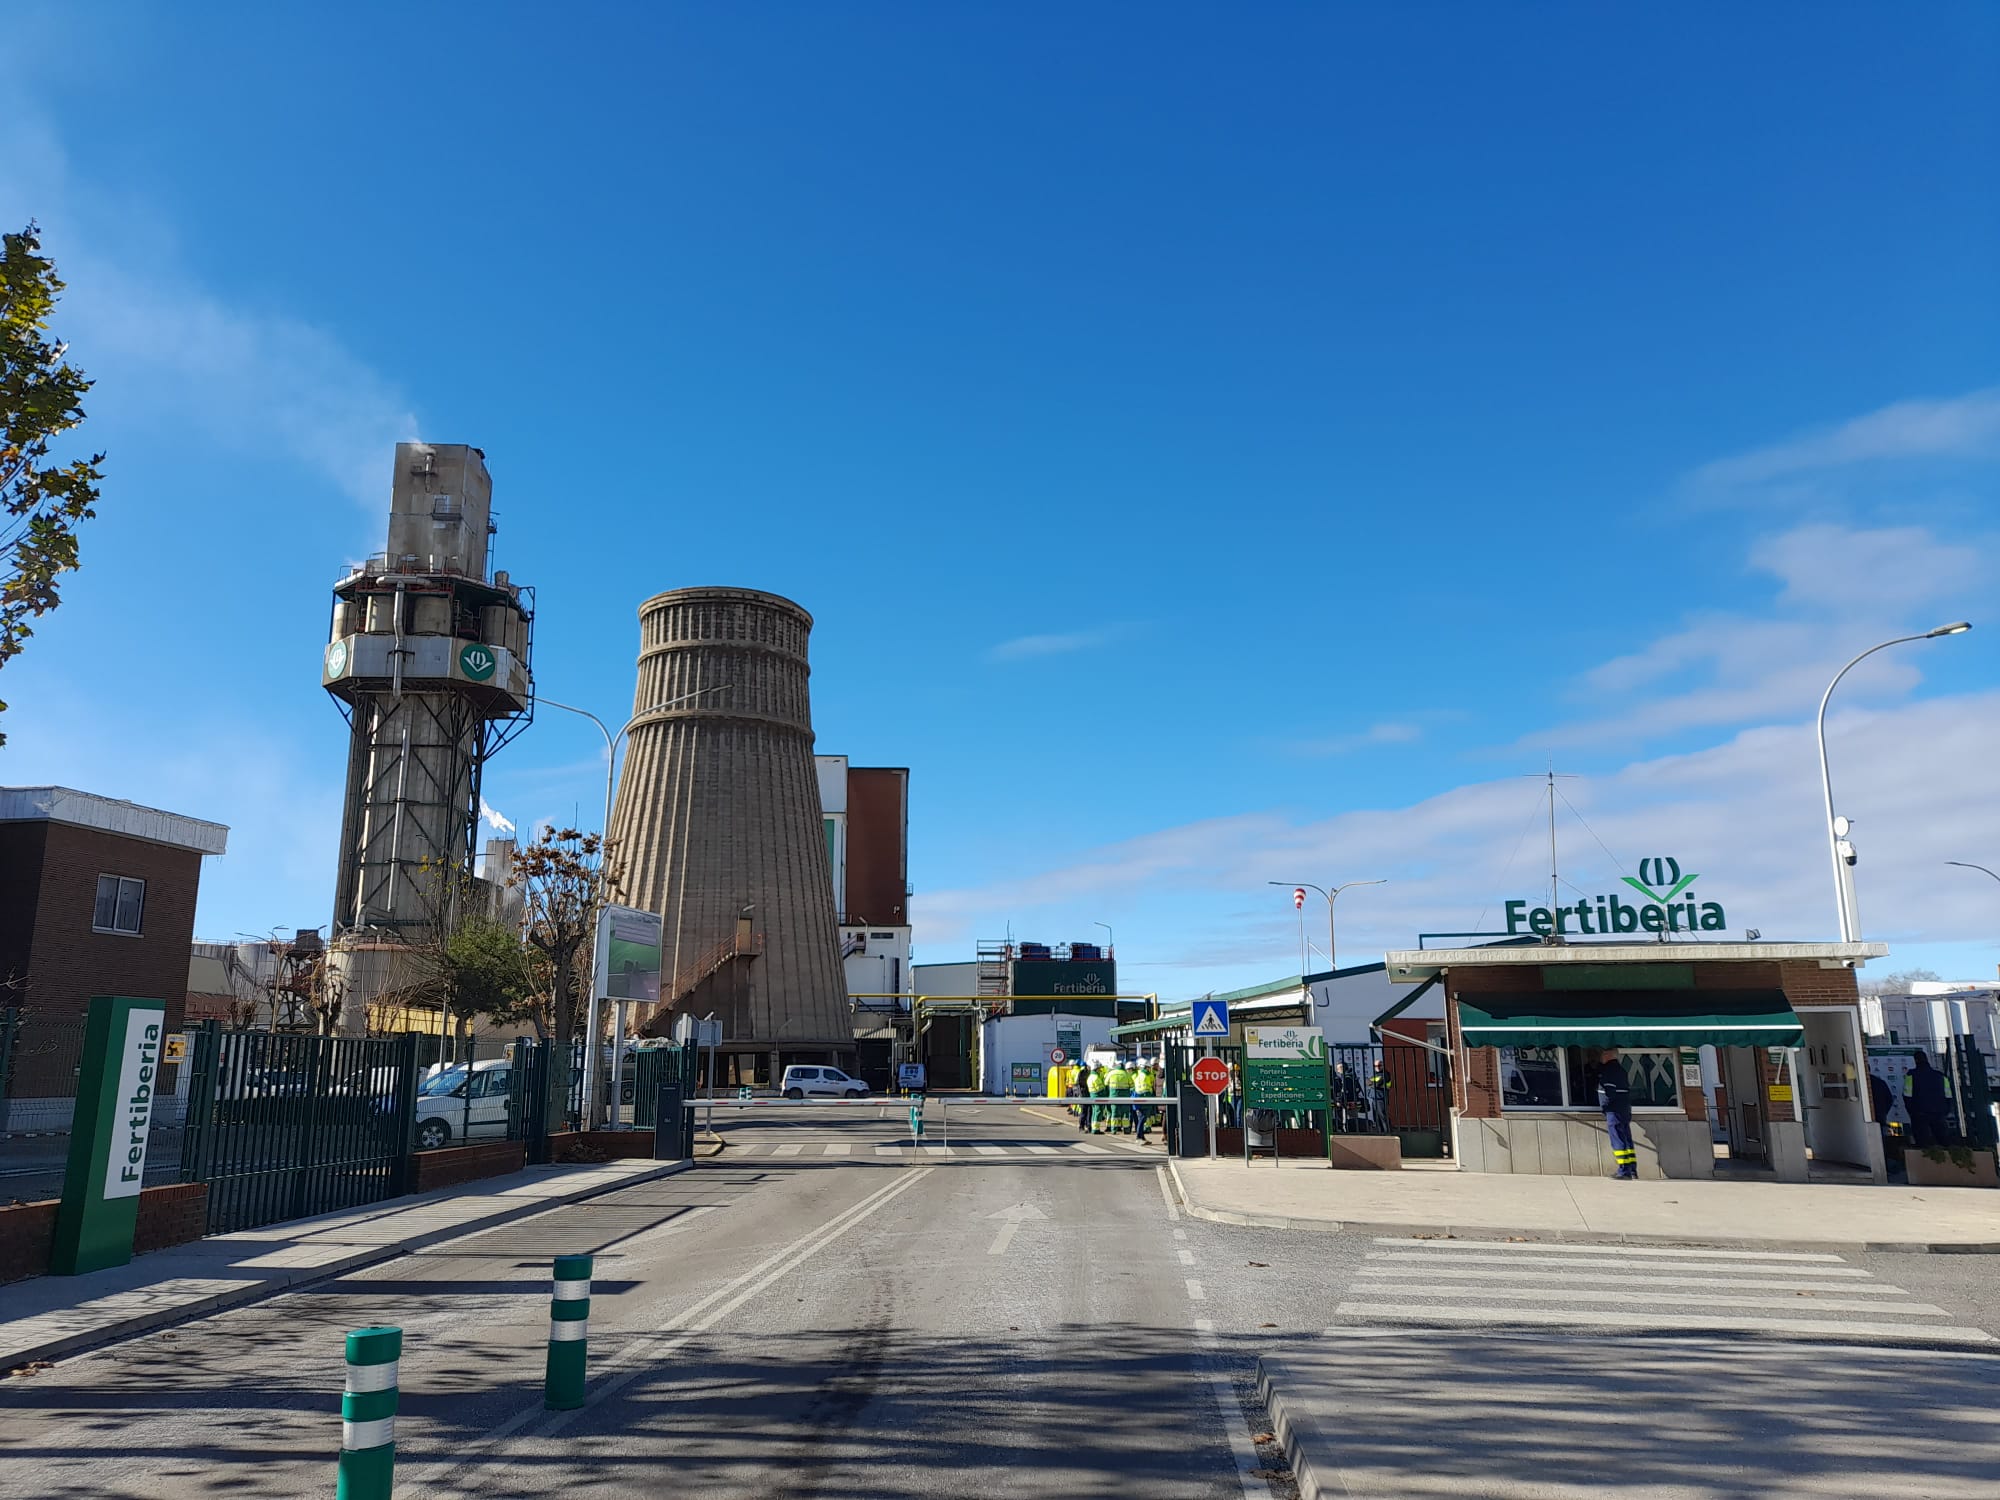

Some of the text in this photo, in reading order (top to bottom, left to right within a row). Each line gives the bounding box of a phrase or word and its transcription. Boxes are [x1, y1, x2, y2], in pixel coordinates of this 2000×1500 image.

[1505, 892, 1726, 936] Fertiberia
[1054, 982, 1106, 993] Fertiberia
[1258, 1039, 1304, 1049] Fertiberia
[1196, 1071, 1227, 1081] STOP
[1260, 1092, 1305, 1100] Expediciones
[121, 1024, 159, 1183] Fertiberia
